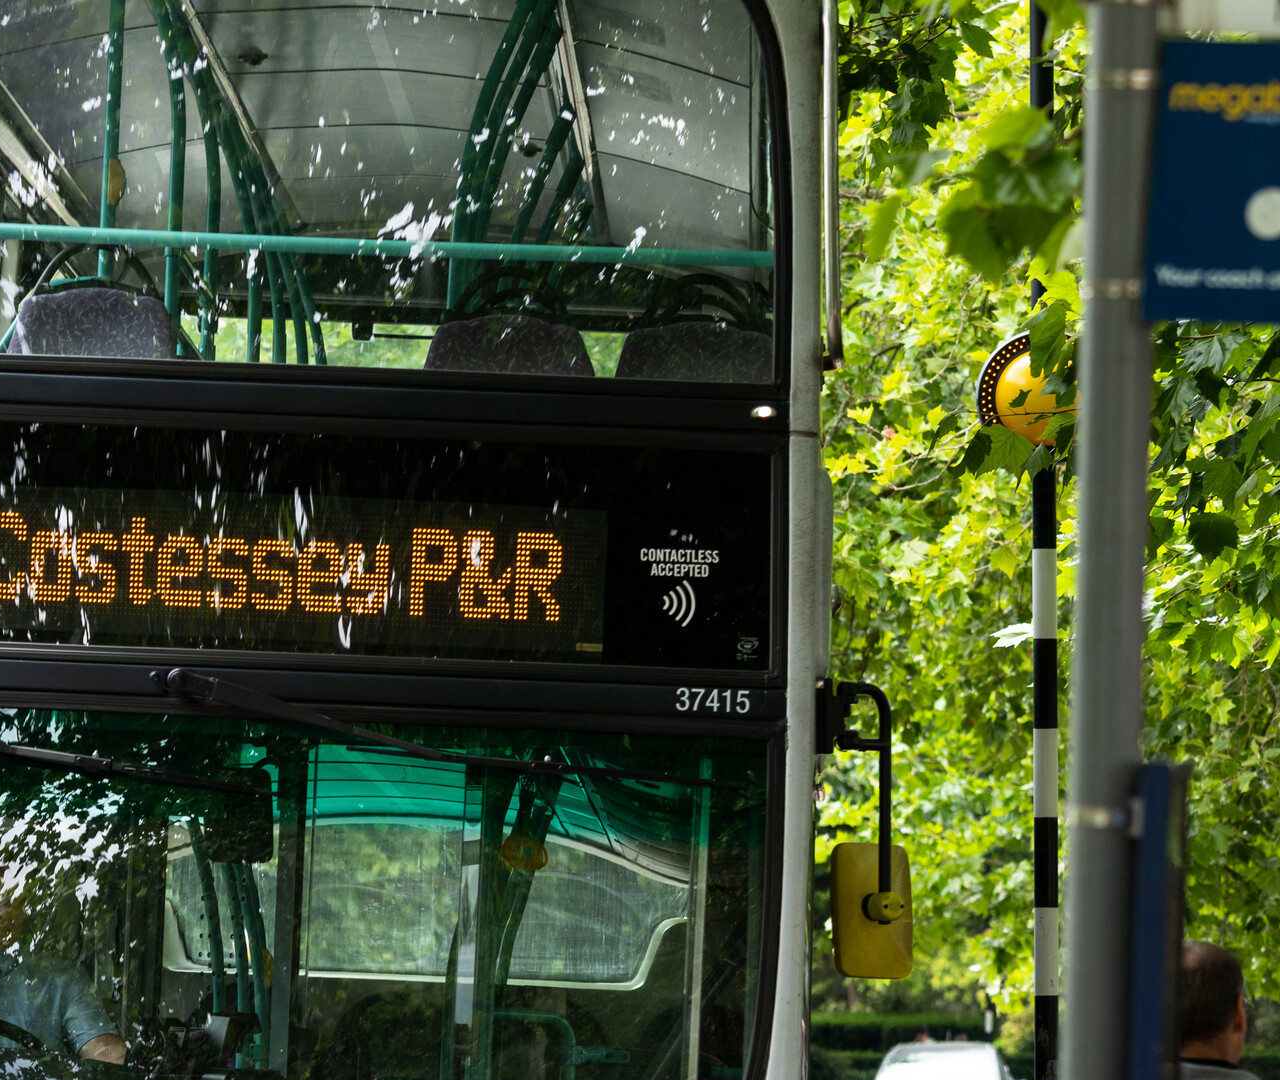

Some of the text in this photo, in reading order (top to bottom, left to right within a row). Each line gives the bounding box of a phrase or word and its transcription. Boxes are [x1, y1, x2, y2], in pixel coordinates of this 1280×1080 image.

[1155, 264, 1202, 288] Your
[1204, 266, 1265, 289] coach
[640, 548, 720, 563] CONTACTLESS
[410, 527, 562, 622] P&R
[650, 563, 710, 577] ACCEPTED
[675, 687, 750, 714] 37415
